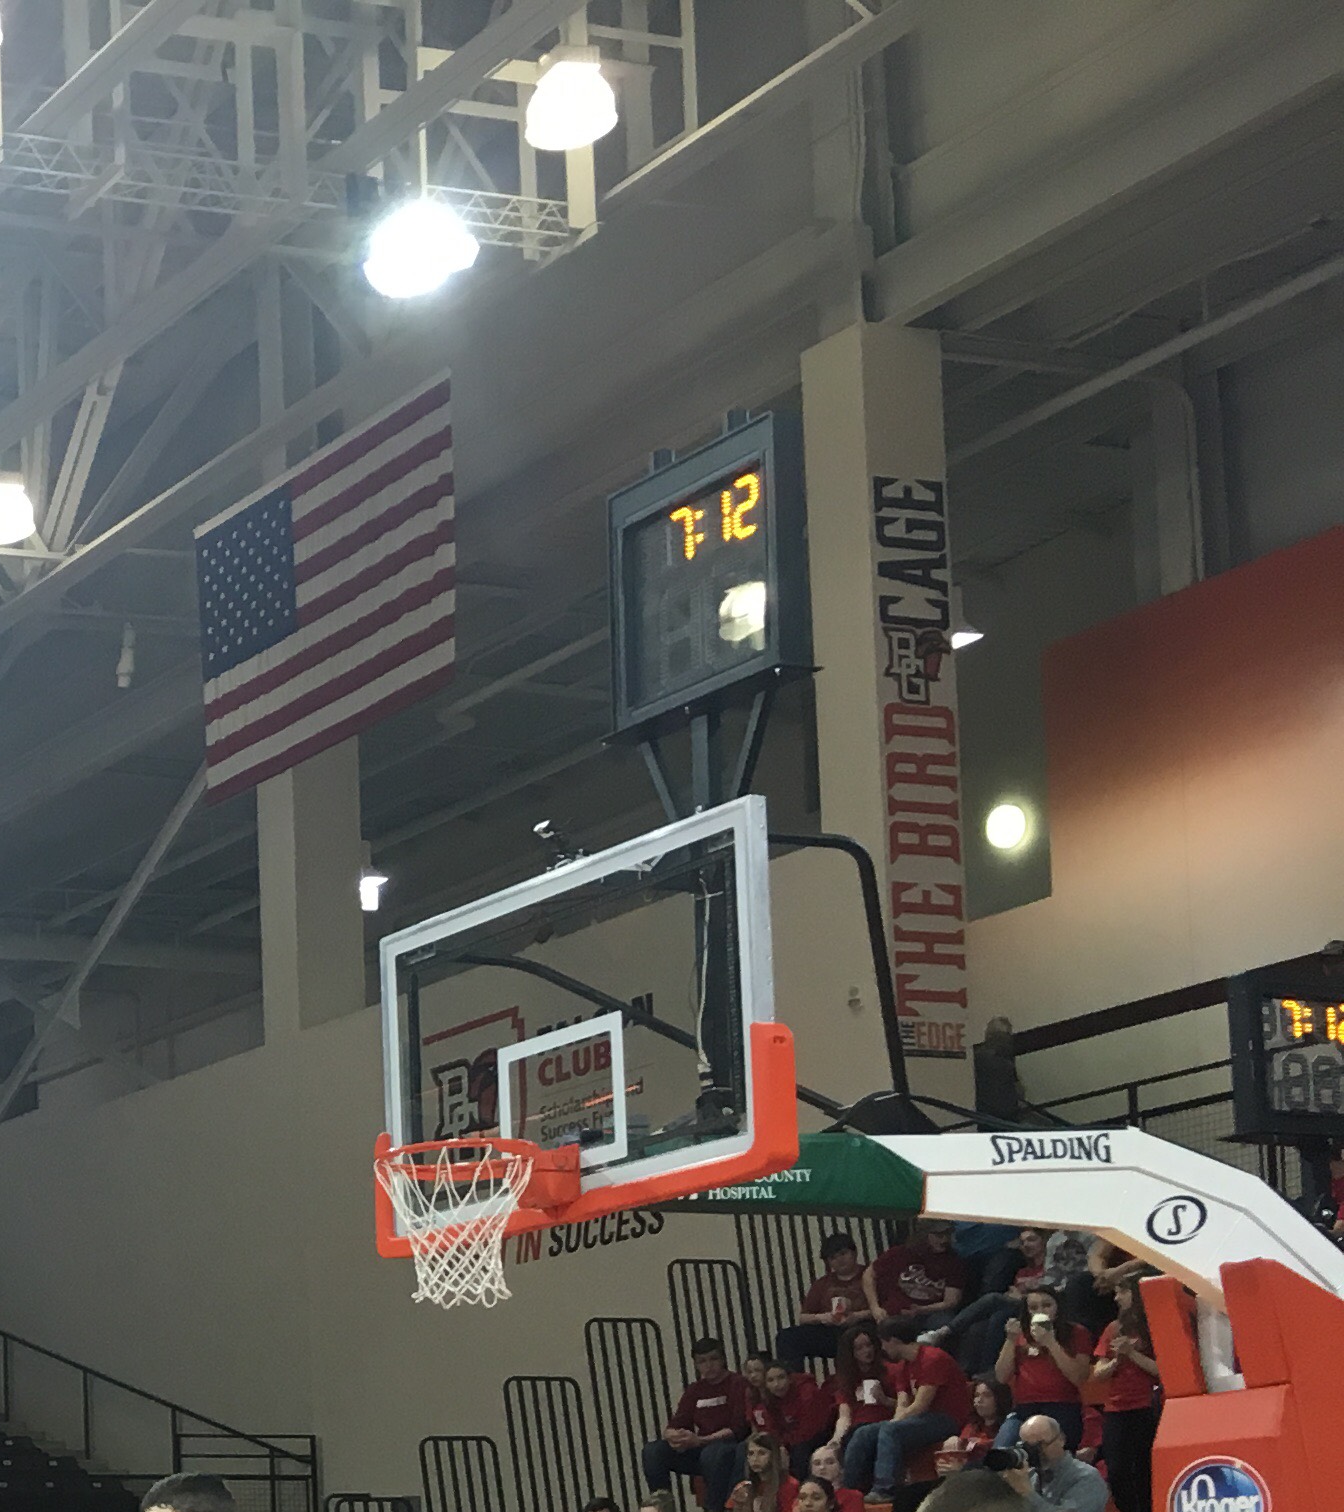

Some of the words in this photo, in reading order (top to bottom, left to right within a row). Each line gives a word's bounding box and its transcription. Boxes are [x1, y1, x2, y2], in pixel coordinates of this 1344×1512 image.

[670, 473, 760, 560] 7:12
[872, 476, 950, 631] CAGE
[884, 702, 962, 864] BIRD
[892, 881, 969, 1017] THE
[915, 1021, 967, 1052] EDGE
[538, 1040, 613, 1087] CLUB
[990, 1132, 1113, 1167] SPALDING
[707, 1185, 777, 1200] HOSPITAL
[548, 1210, 666, 1258] SUCCESS
